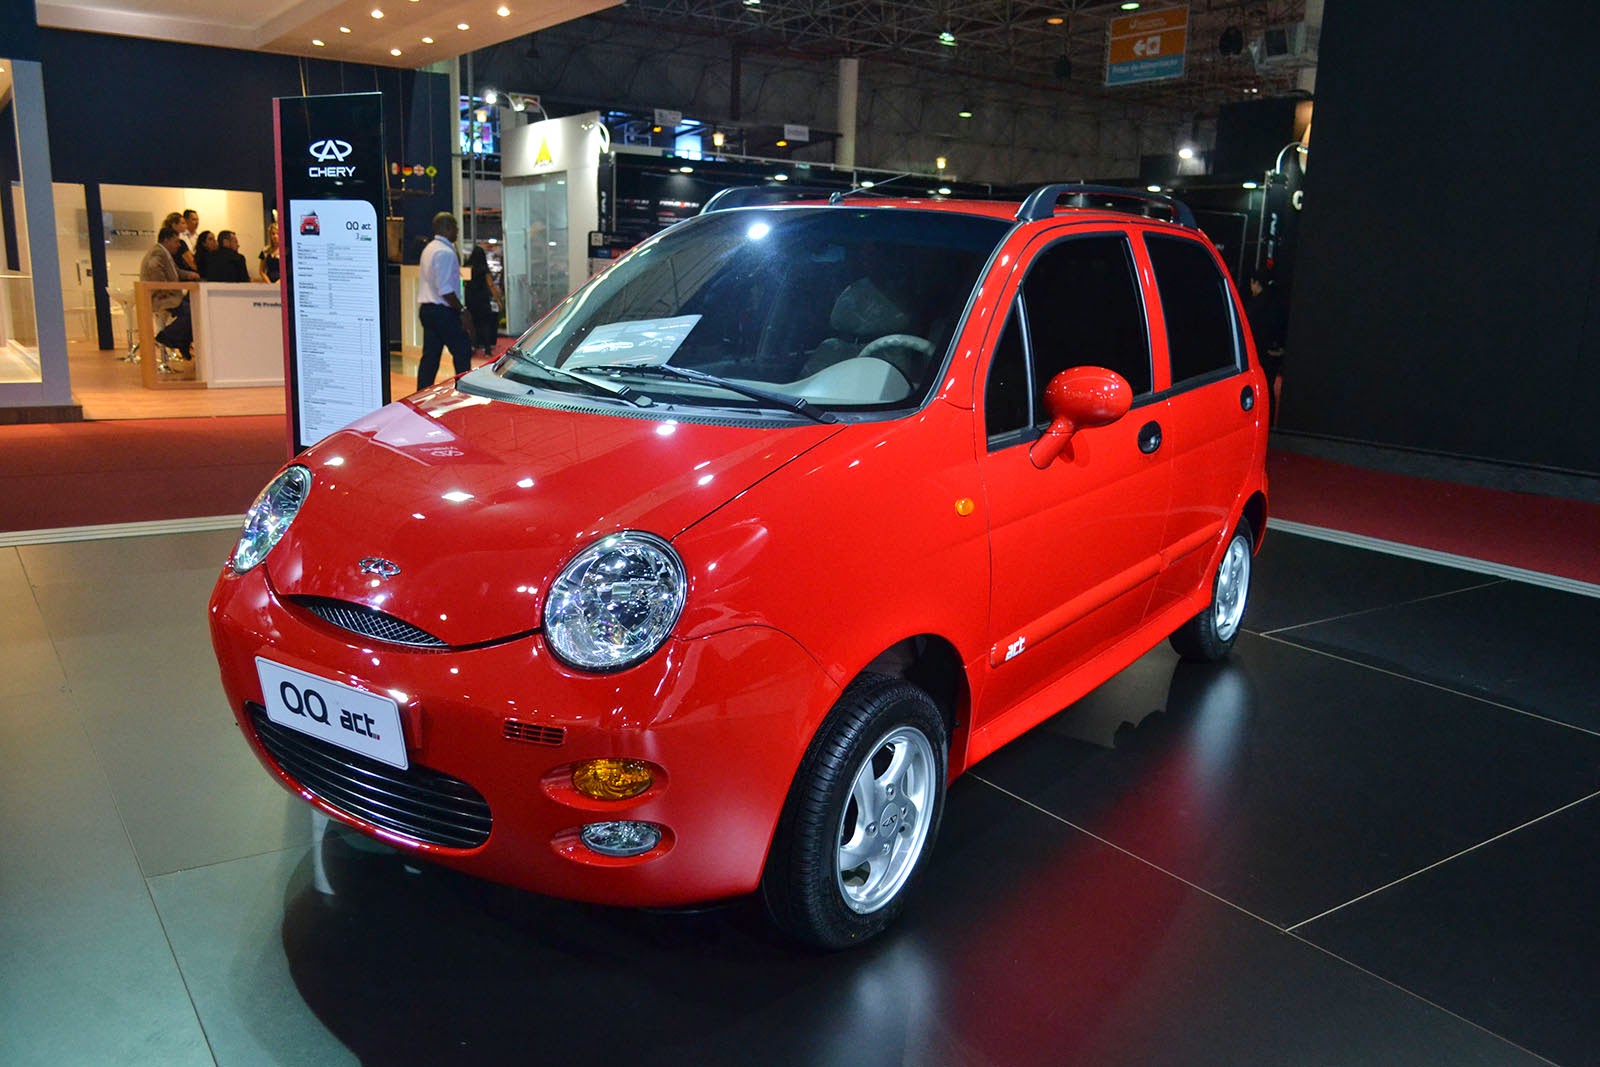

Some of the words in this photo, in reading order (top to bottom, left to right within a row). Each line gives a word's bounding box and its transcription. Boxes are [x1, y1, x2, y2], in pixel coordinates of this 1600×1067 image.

[308, 166, 356, 178] CHERY
[1005, 636, 1026, 662] act
[279, 681, 331, 727] QQ
